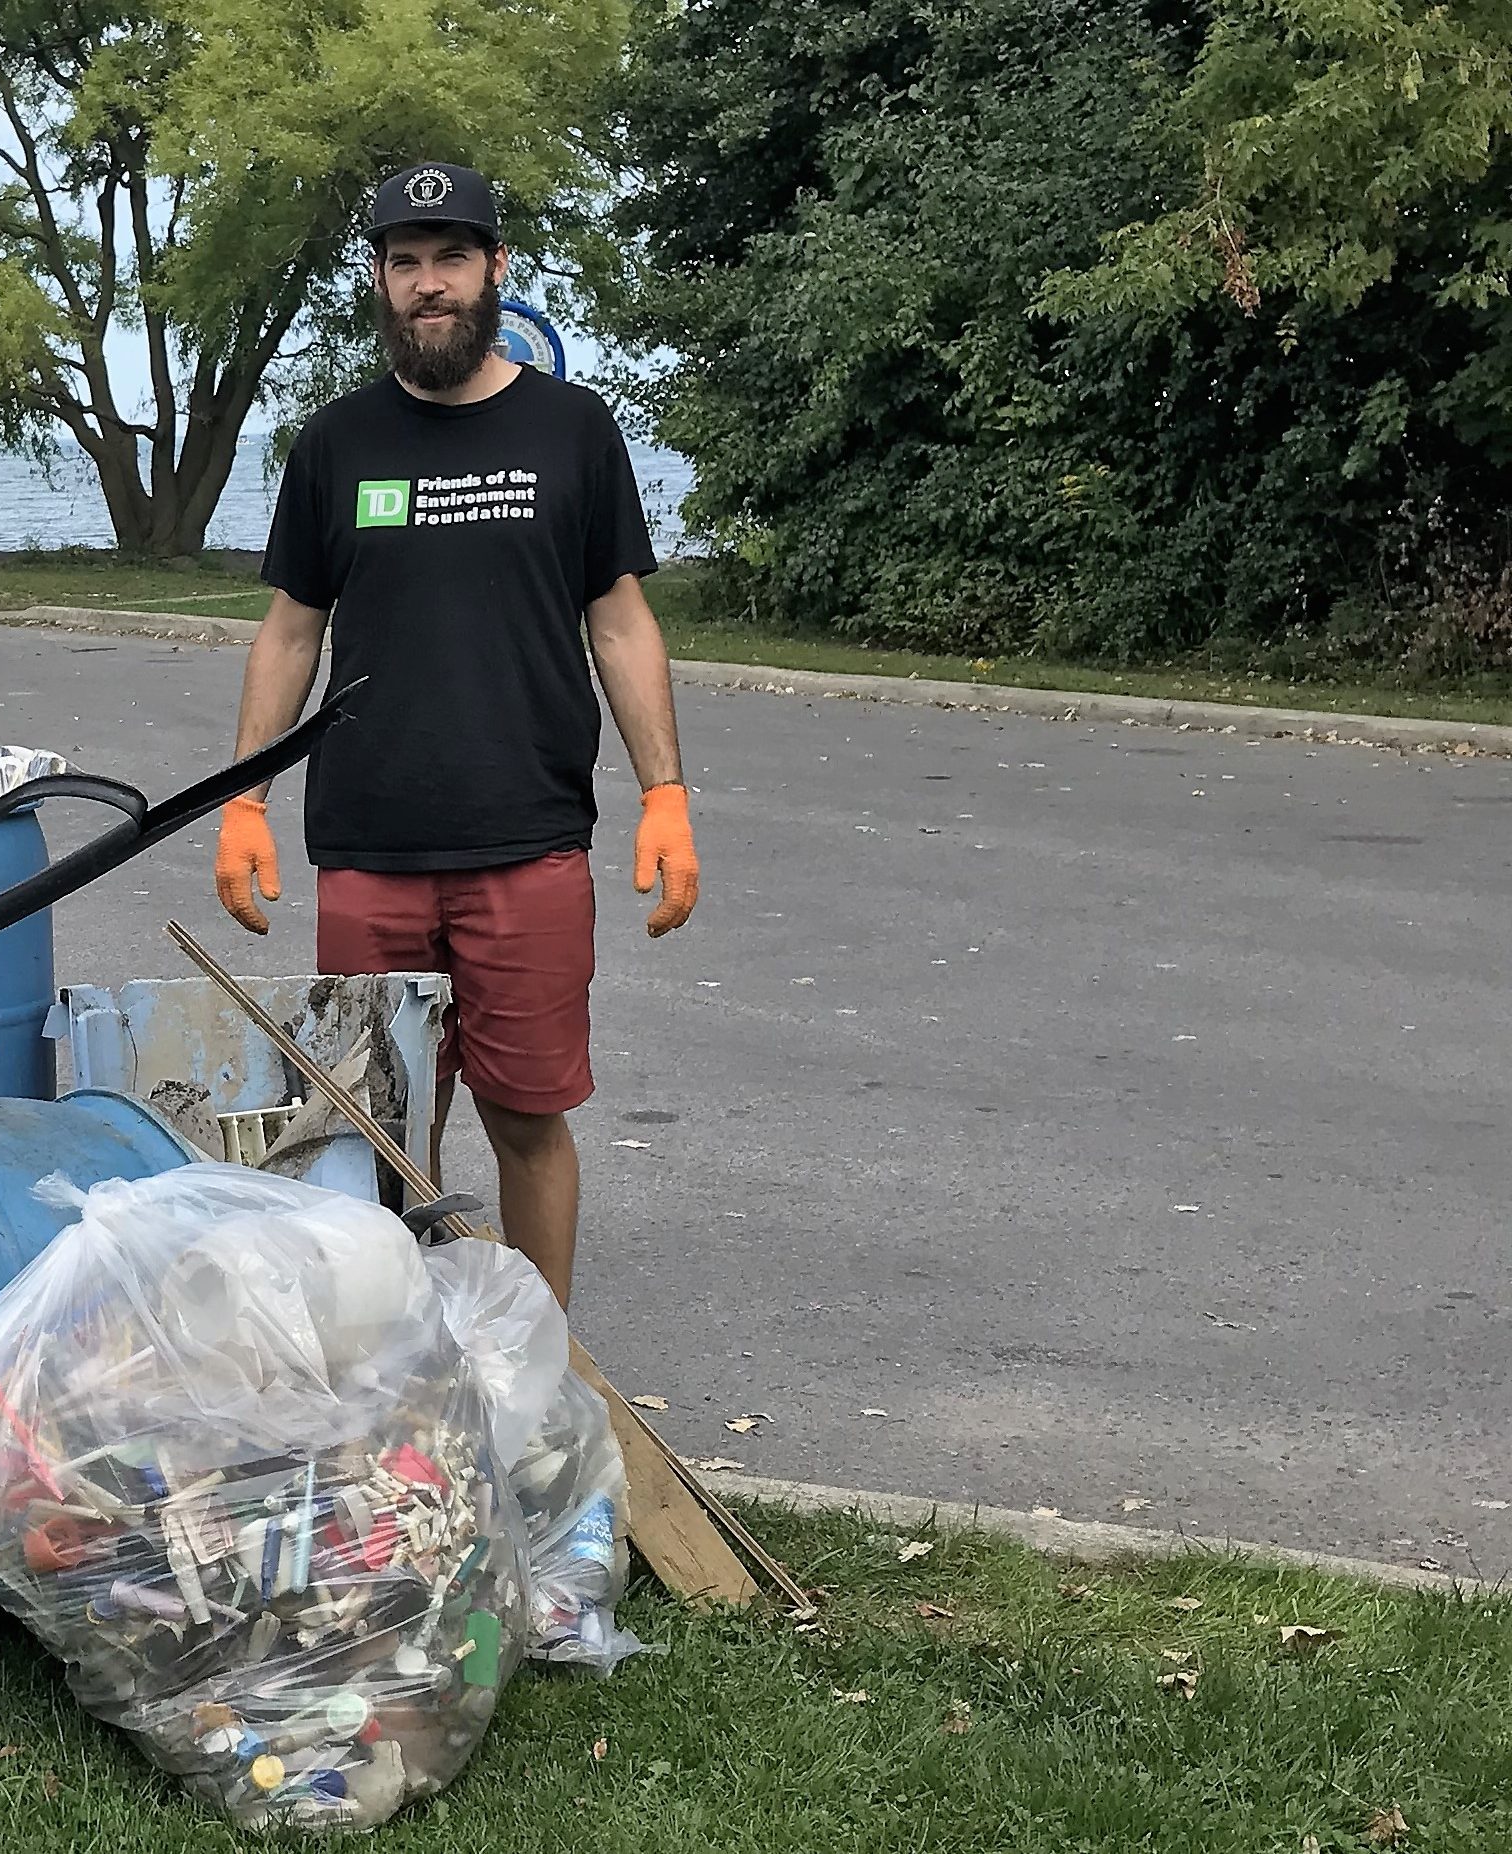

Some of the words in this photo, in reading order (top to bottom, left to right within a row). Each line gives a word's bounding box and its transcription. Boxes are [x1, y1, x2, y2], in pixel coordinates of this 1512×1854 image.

[417, 473, 482, 491] Friends
[485, 470, 506, 485] of
[508, 469, 538, 484] the
[362, 488, 405, 518] TD
[416, 487, 536, 509] Environment
[414, 504, 535, 526] Foundation
